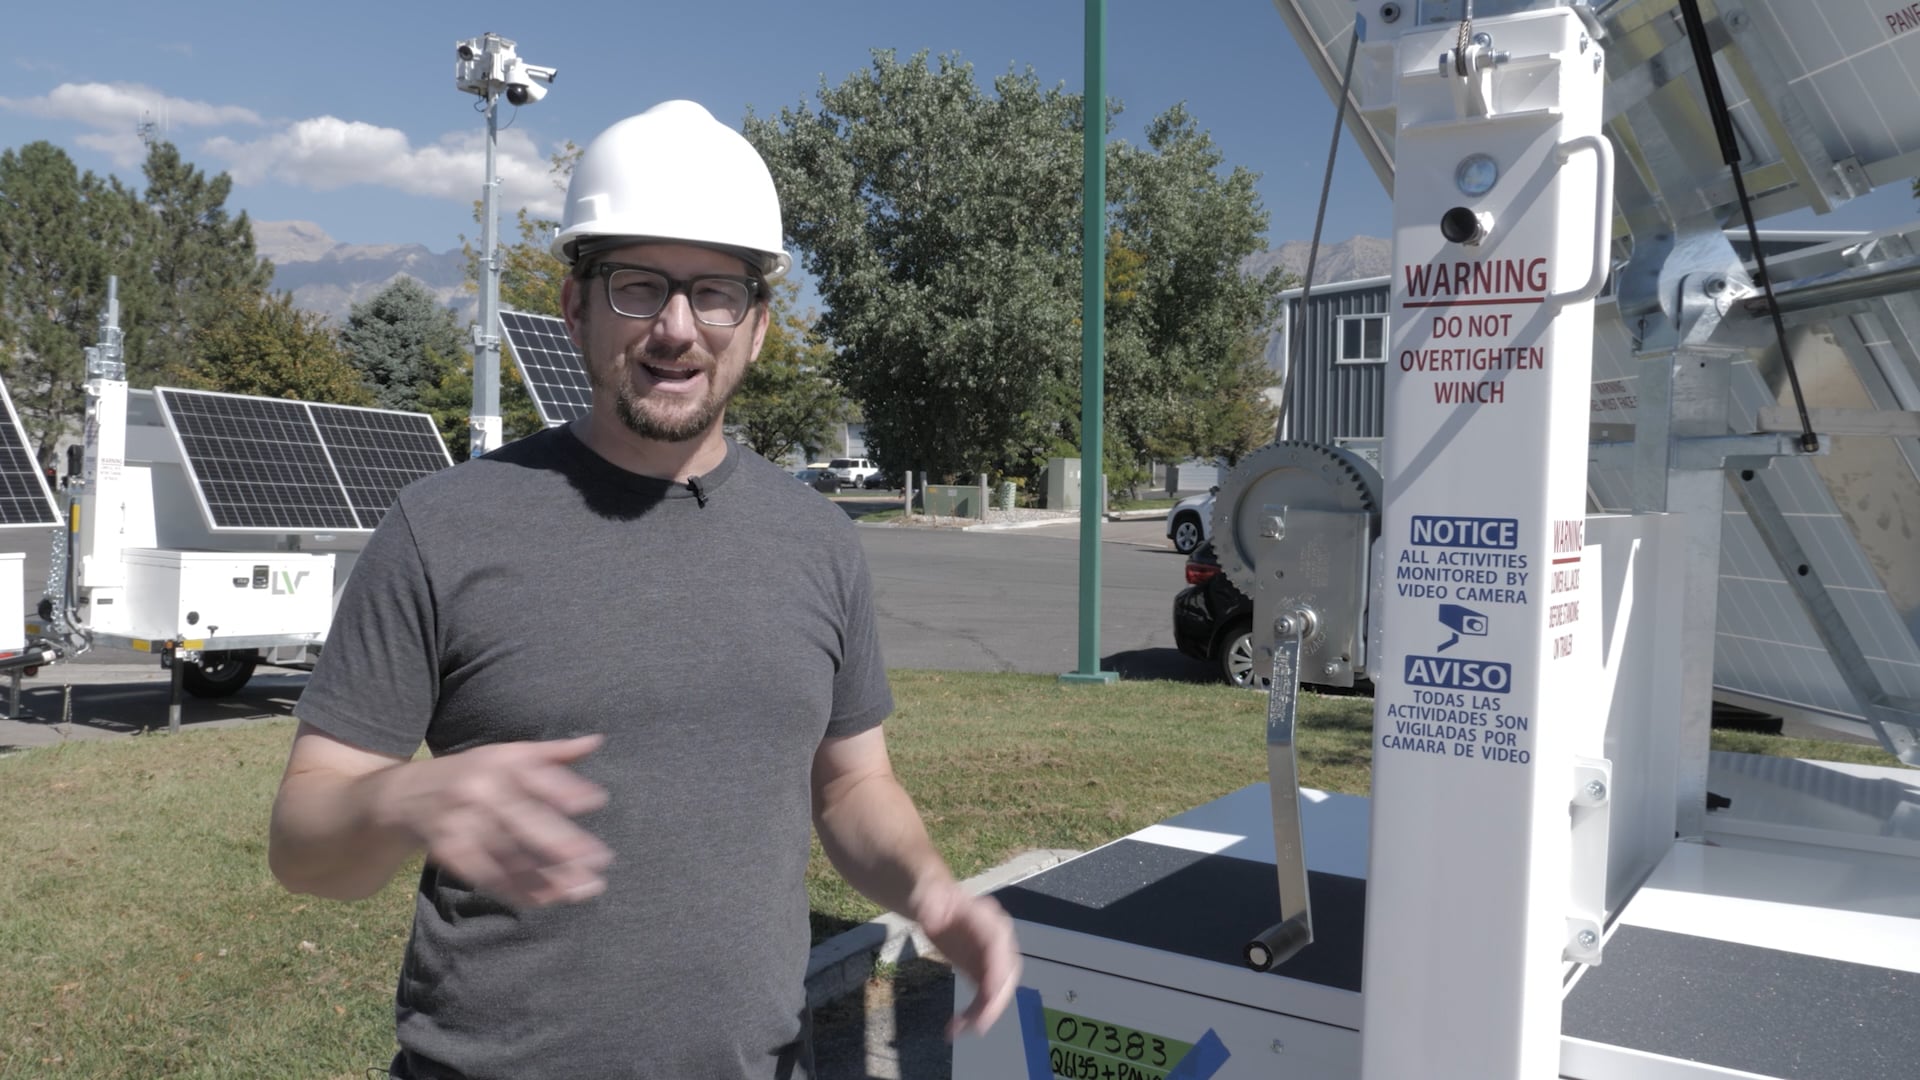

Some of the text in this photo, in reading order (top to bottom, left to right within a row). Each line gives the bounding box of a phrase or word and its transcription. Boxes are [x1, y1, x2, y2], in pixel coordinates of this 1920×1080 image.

[1405, 257, 1547, 297] WARNING
[1433, 314, 1513, 339] DO NOT
[1400, 347, 1544, 372] OVERTIGHTEN
[1434, 381, 1505, 404] WINCH
[1412, 519, 1515, 547] NOTICE
[1553, 520, 1583, 553] WARNING
[1400, 549, 1528, 569] ALL ACTIVITIES
[1397, 567, 1529, 587] MONITORED BY
[1397, 583, 1528, 604] VIDEO CAMERA
[1407, 659, 1508, 690] AVISO
[1413, 690, 1501, 711] TODAS LAS
[1387, 704, 1528, 731] ACTIVIDADES SON
[1395, 720, 1517, 747] VIGILADAS POR
[1382, 735, 1531, 764] CAMARA DE VIDEO
[1056, 1016, 1168, 1067] 07383
